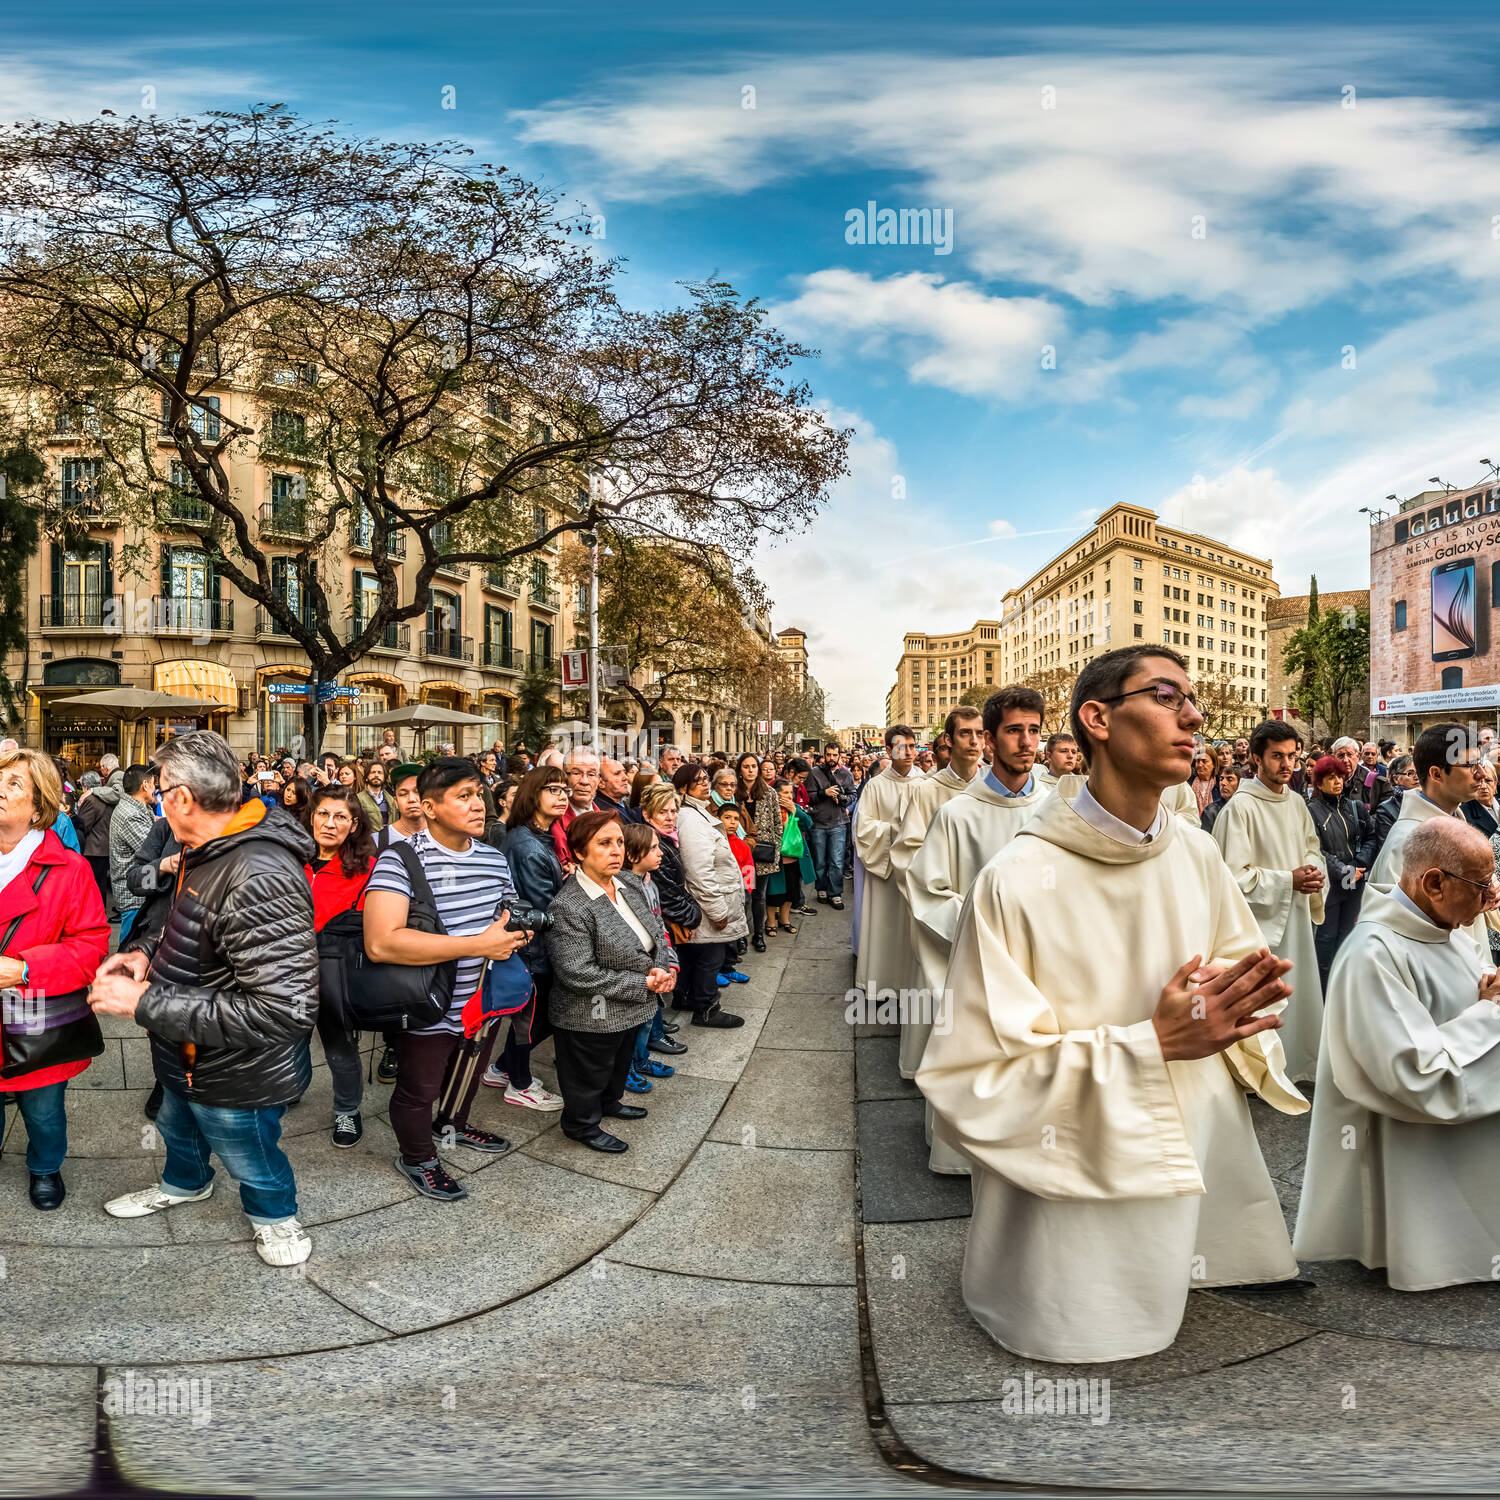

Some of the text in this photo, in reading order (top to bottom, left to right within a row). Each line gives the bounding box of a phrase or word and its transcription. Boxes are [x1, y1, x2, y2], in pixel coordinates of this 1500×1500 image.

[1406, 537, 1439, 556] NEXT
[1446, 531, 1458, 542] IS
[1406, 556, 1434, 569] SAMSUNG
[1435, 539, 1483, 560] Galaxy
